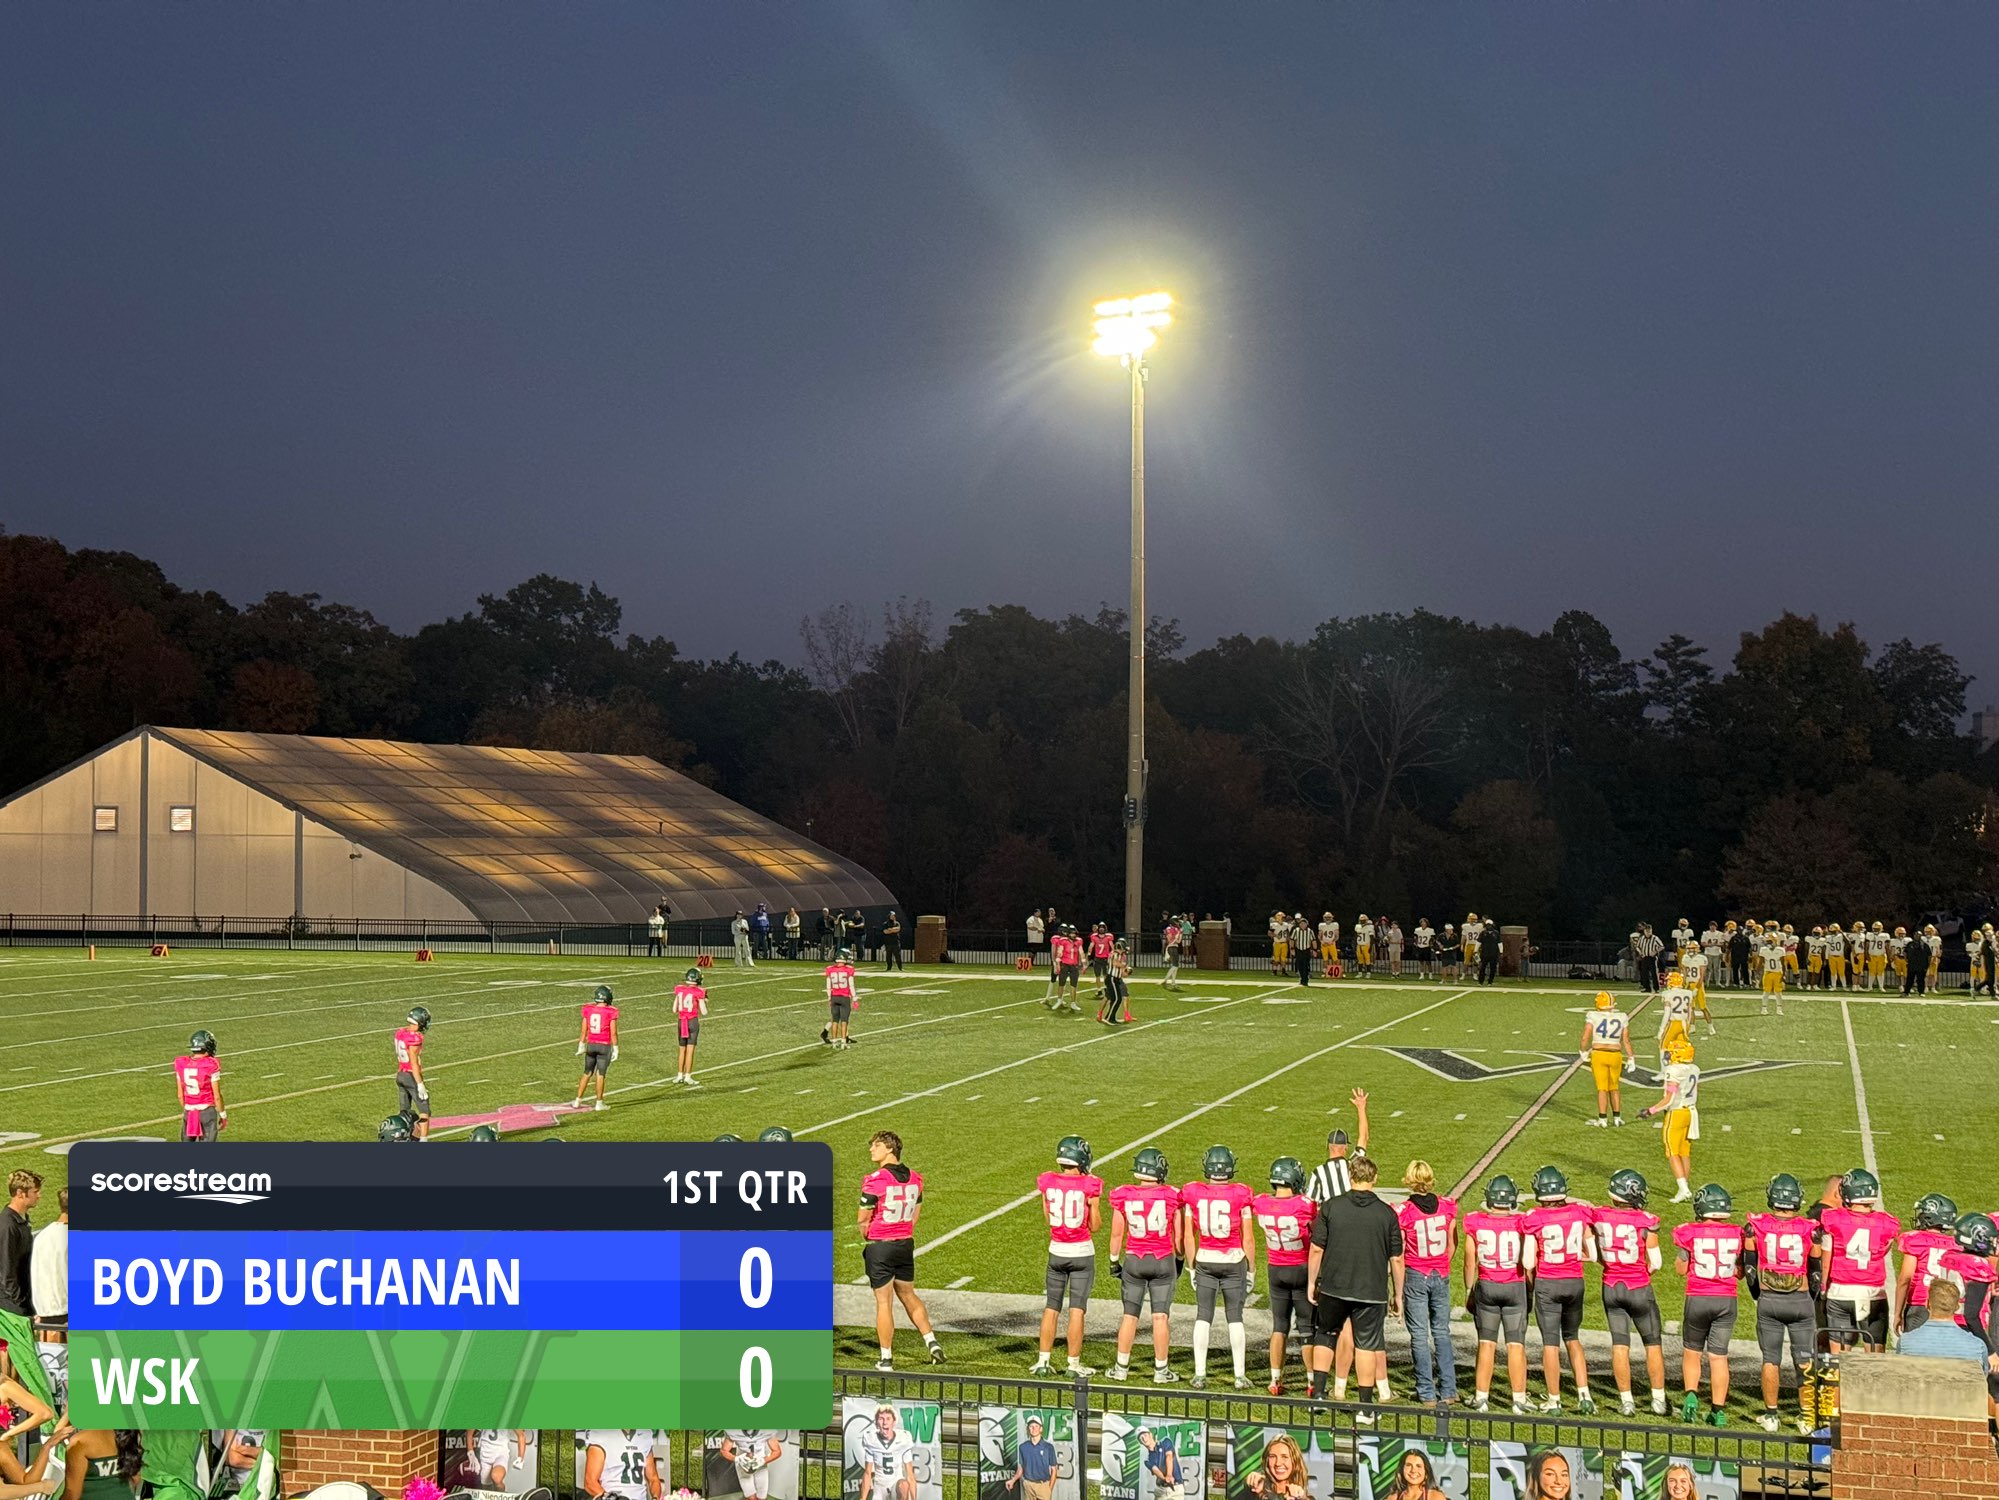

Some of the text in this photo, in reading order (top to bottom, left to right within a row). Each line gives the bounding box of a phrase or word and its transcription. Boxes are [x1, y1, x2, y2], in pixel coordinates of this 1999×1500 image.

[1468, 932, 1479, 940] 82
[1871, 940, 1882, 950] 78
[417, 950, 428, 961] 10
[1070, 948, 1074, 960] 1
[1098, 944, 1104, 954] 7
[1830, 942, 1841, 952] 50
[698, 955, 710, 967] 20
[1018, 958, 1029, 970] 30
[1328, 966, 1340, 977] 40
[1770, 958, 1776, 970] 0
[831, 972, 848, 989] 25
[677, 992, 693, 1012] 14
[1672, 996, 1690, 1014] 23
[590, 1014, 600, 1034] 9
[1596, 1019, 1622, 1040] 42
[184, 1068, 200, 1096] 5
[1685, 1074, 1698, 1098] 2
[882, 1184, 919, 1223] 58
[1046, 1188, 1085, 1229] 30
[1124, 1200, 1168, 1239] 54
[1196, 1199, 1231, 1239] 16
[1258, 1215, 1304, 1251] 52
[1414, 1216, 1448, 1258] 15
[1542, 1220, 1584, 1264] 24
[1594, 1222, 1639, 1264] 23
[1476, 1230, 1521, 1269] 20
[1694, 1238, 1739, 1280] 55
[1764, 1232, 1804, 1268] 13
[1846, 1228, 1872, 1270] 4
[620, 1452, 644, 1484] 16
[882, 1457, 894, 1475] 5
